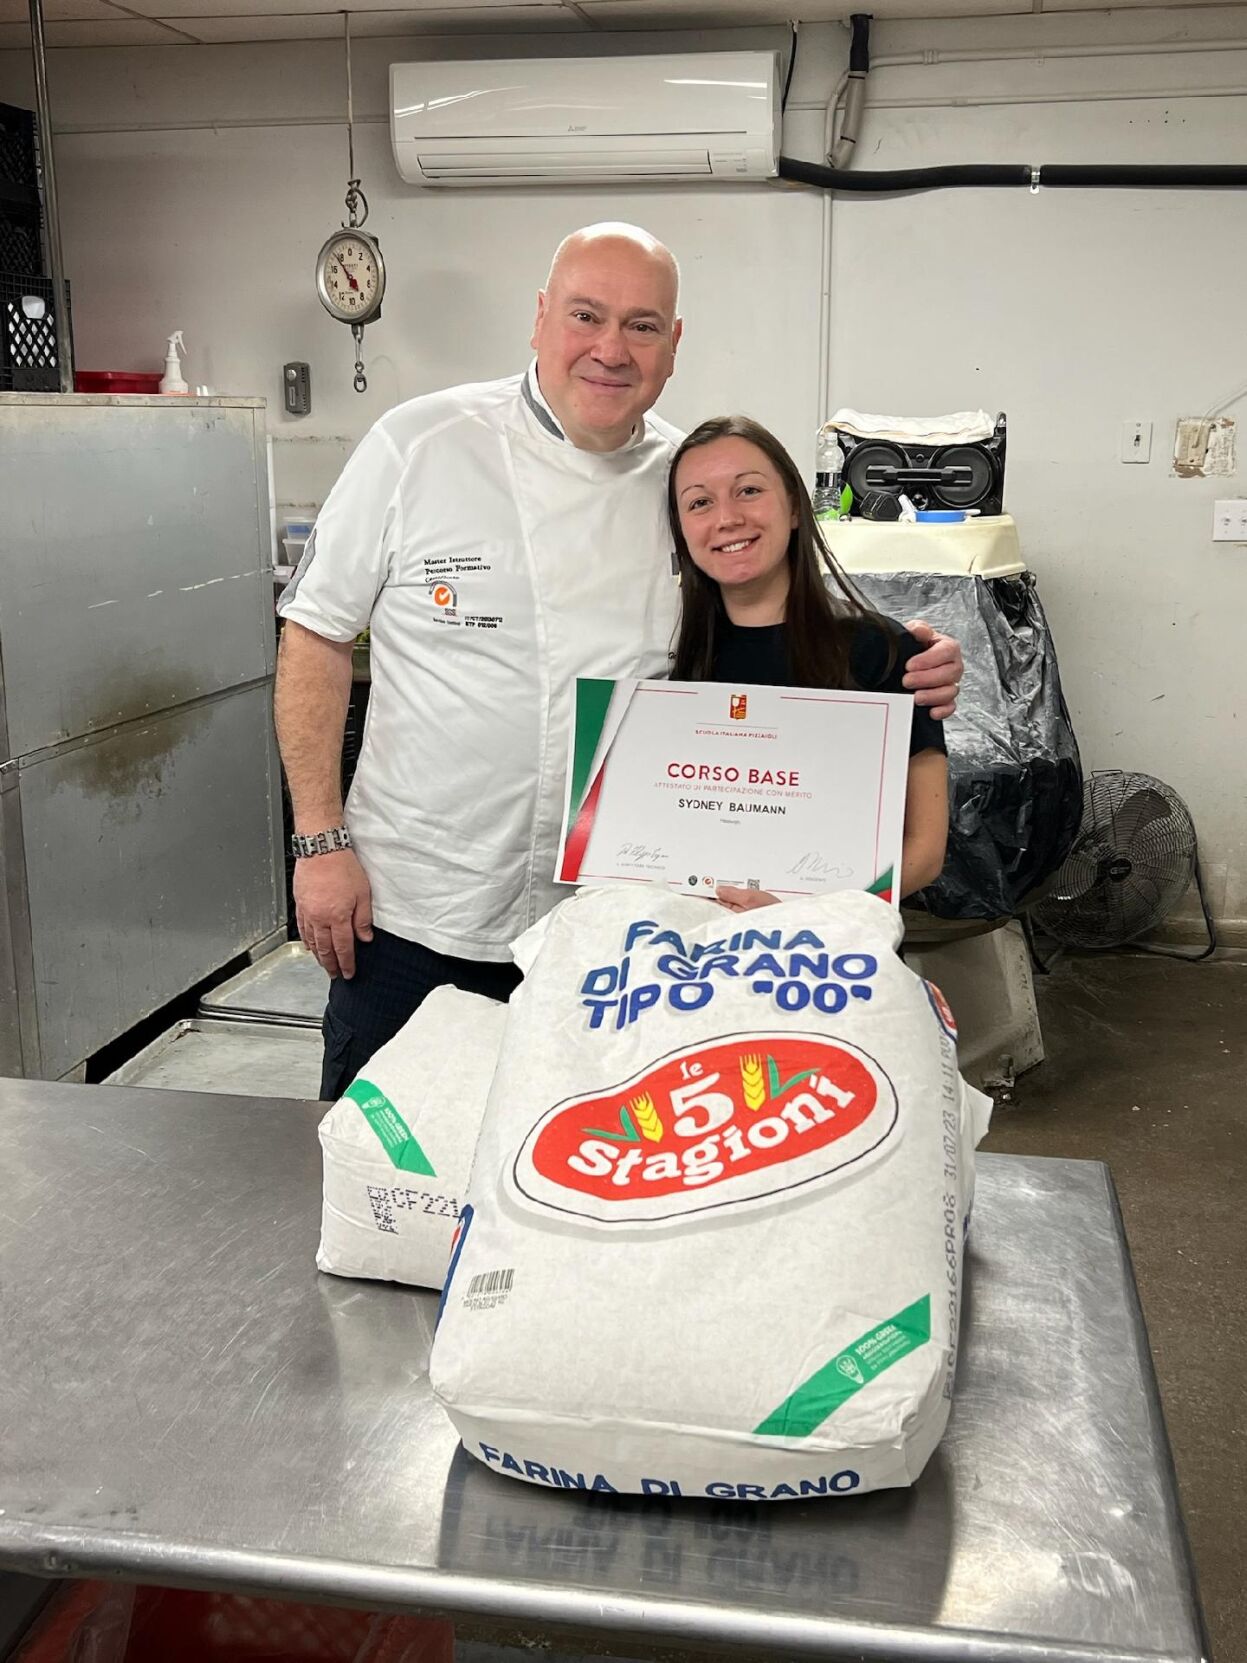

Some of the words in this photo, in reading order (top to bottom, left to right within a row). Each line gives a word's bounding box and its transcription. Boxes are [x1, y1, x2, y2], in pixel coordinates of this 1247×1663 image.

[455, 564, 491, 572] Formativo
[654, 782, 691, 790] ATTESTATO
[704, 785, 764, 795] PARTECIPAZIONE
[785, 791, 813, 799] MERITO
[667, 763, 739, 782] CORSO
[749, 768, 800, 786] BASE
[678, 798, 723, 811] SYDNEY
[729, 802, 786, 814] BAUMANN
[580, 957, 630, 996] DI
[657, 953, 878, 981] GRANO
[581, 981, 715, 1030] TIPO
[680, 1061, 704, 1080] le
[669, 1073, 735, 1138] 5
[567, 1074, 856, 1186] Stagioni
[943, 1109, 957, 1180] 31/07/23
[479, 1442, 618, 1493] FARINA
[641, 1478, 682, 1497] DI
[705, 1469, 860, 1499] GRANO
